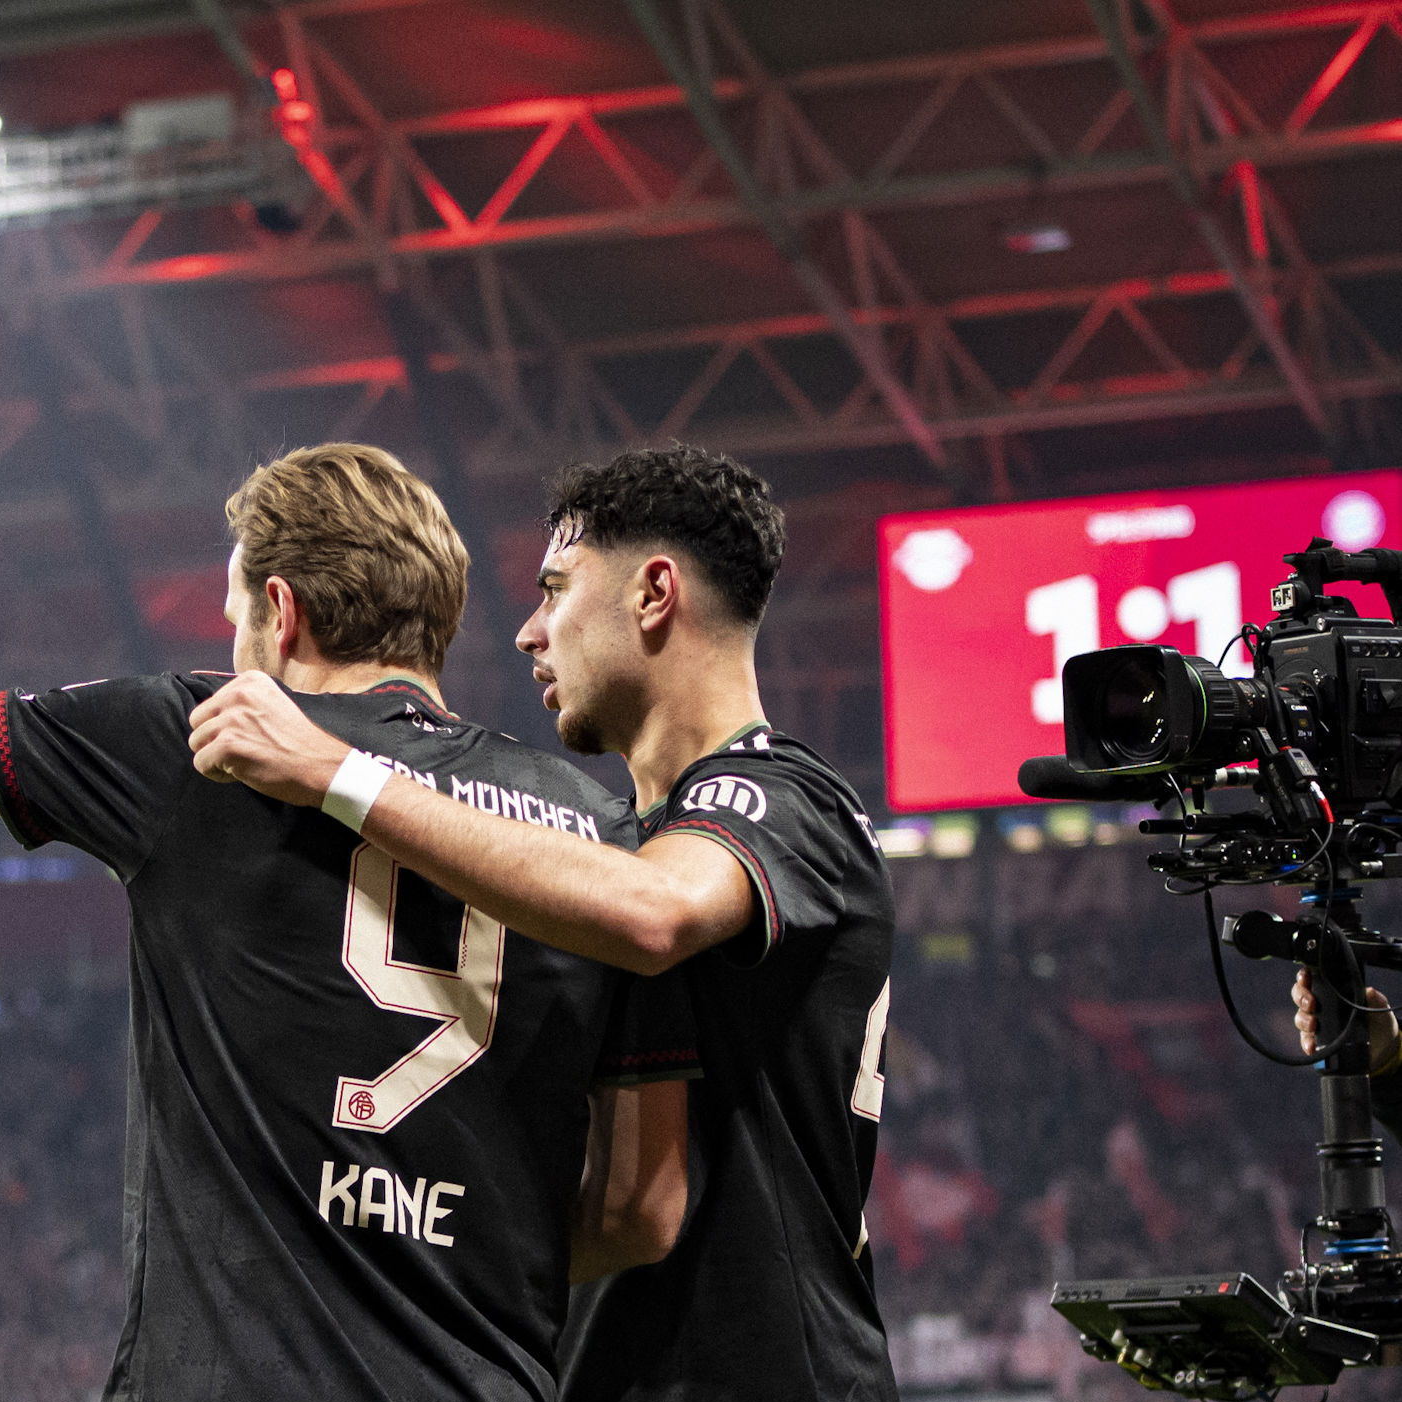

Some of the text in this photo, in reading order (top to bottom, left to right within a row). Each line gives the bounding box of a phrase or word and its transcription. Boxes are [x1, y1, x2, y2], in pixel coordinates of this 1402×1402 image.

[451, 774, 601, 843] MÜNCHEN
[332, 840, 506, 1134] 9
[318, 1160, 466, 1248] KANE
